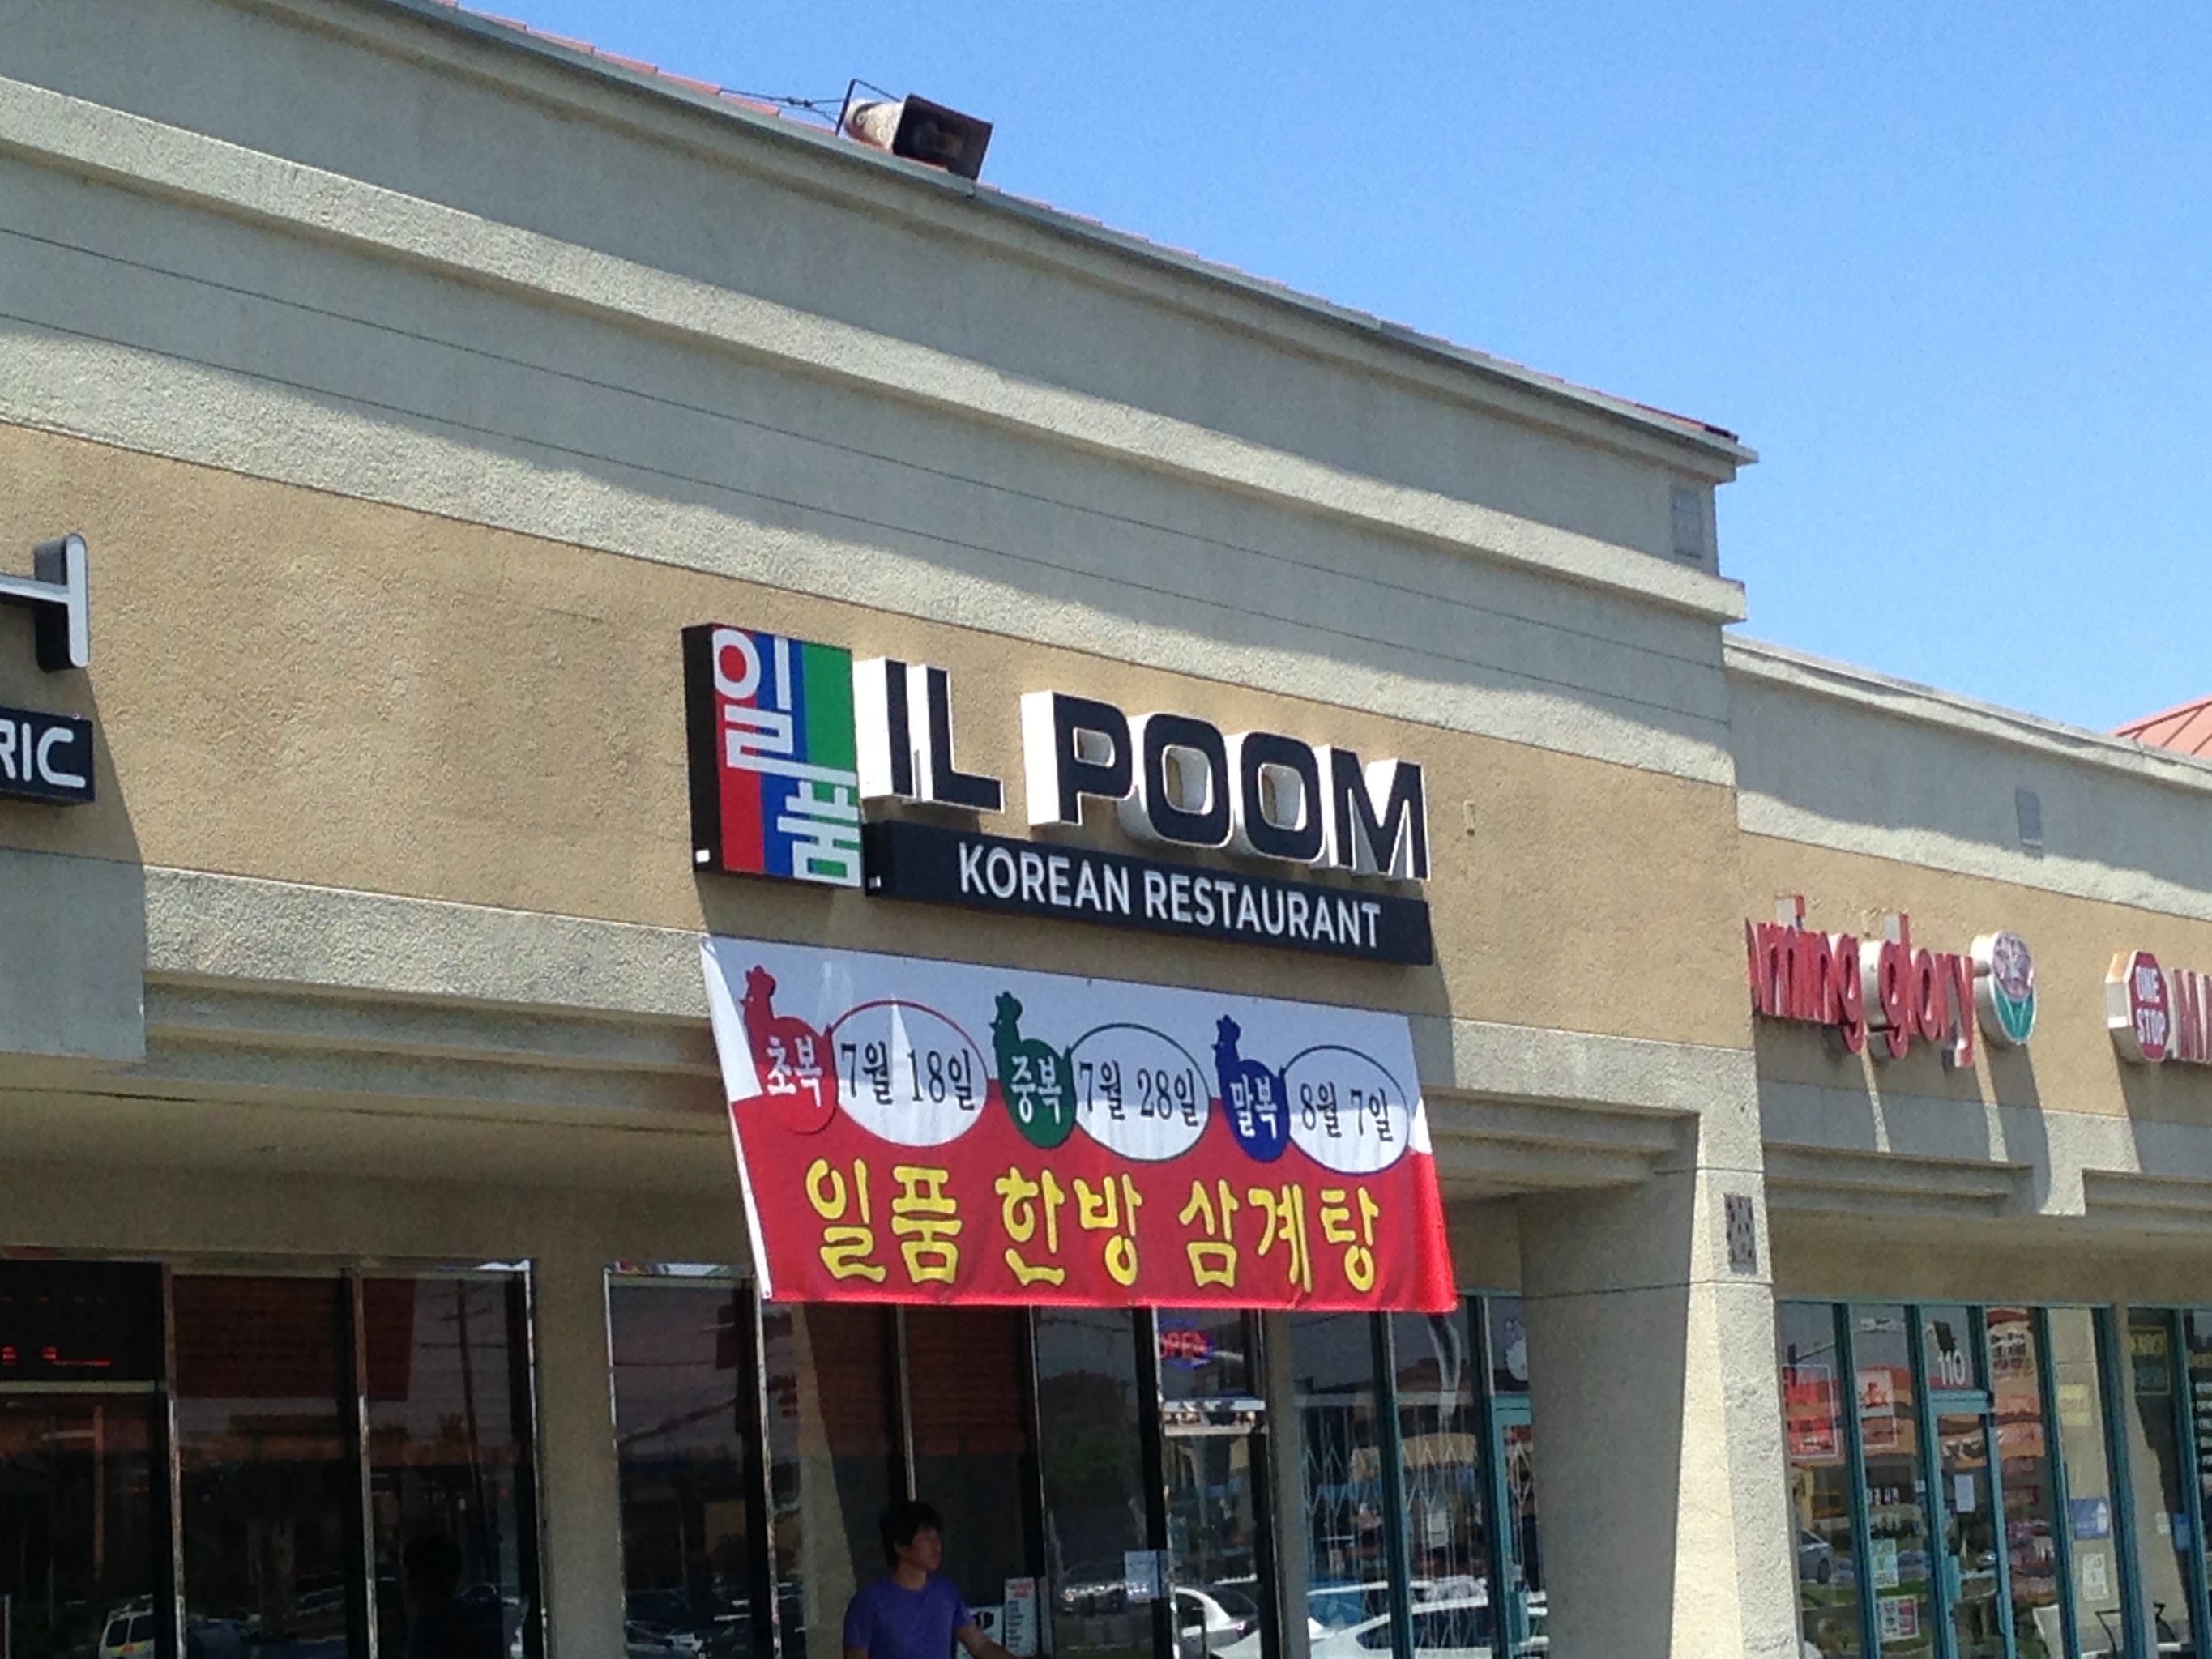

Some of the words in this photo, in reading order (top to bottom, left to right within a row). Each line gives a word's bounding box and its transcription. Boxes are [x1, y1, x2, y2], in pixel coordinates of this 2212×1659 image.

[711, 628, 863, 888] 일품
[883, 657, 1004, 813] IL
[1050, 690, 1432, 882] POOM
[958, 842, 1131, 915] KOREAN
[1143, 869, 1381, 949] RESTAURANT
[767, 1034, 823, 1108] 초복
[839, 1040, 895, 1106] 7월
[906, 1048, 976, 1111] 18일
[1010, 1055, 1063, 1125] 중복
[1078, 1058, 1127, 1122] 7월
[1136, 1067, 1201, 1128] 28일
[1228, 1073, 1279, 1141] 말복
[1299, 1080, 1343, 1140] 8월
[1348, 1087, 1396, 1144] 7일
[804, 1157, 965, 1286] 일품
[993, 1166, 1146, 1288] 한방
[1177, 1177, 1380, 1294] 삼계탕
